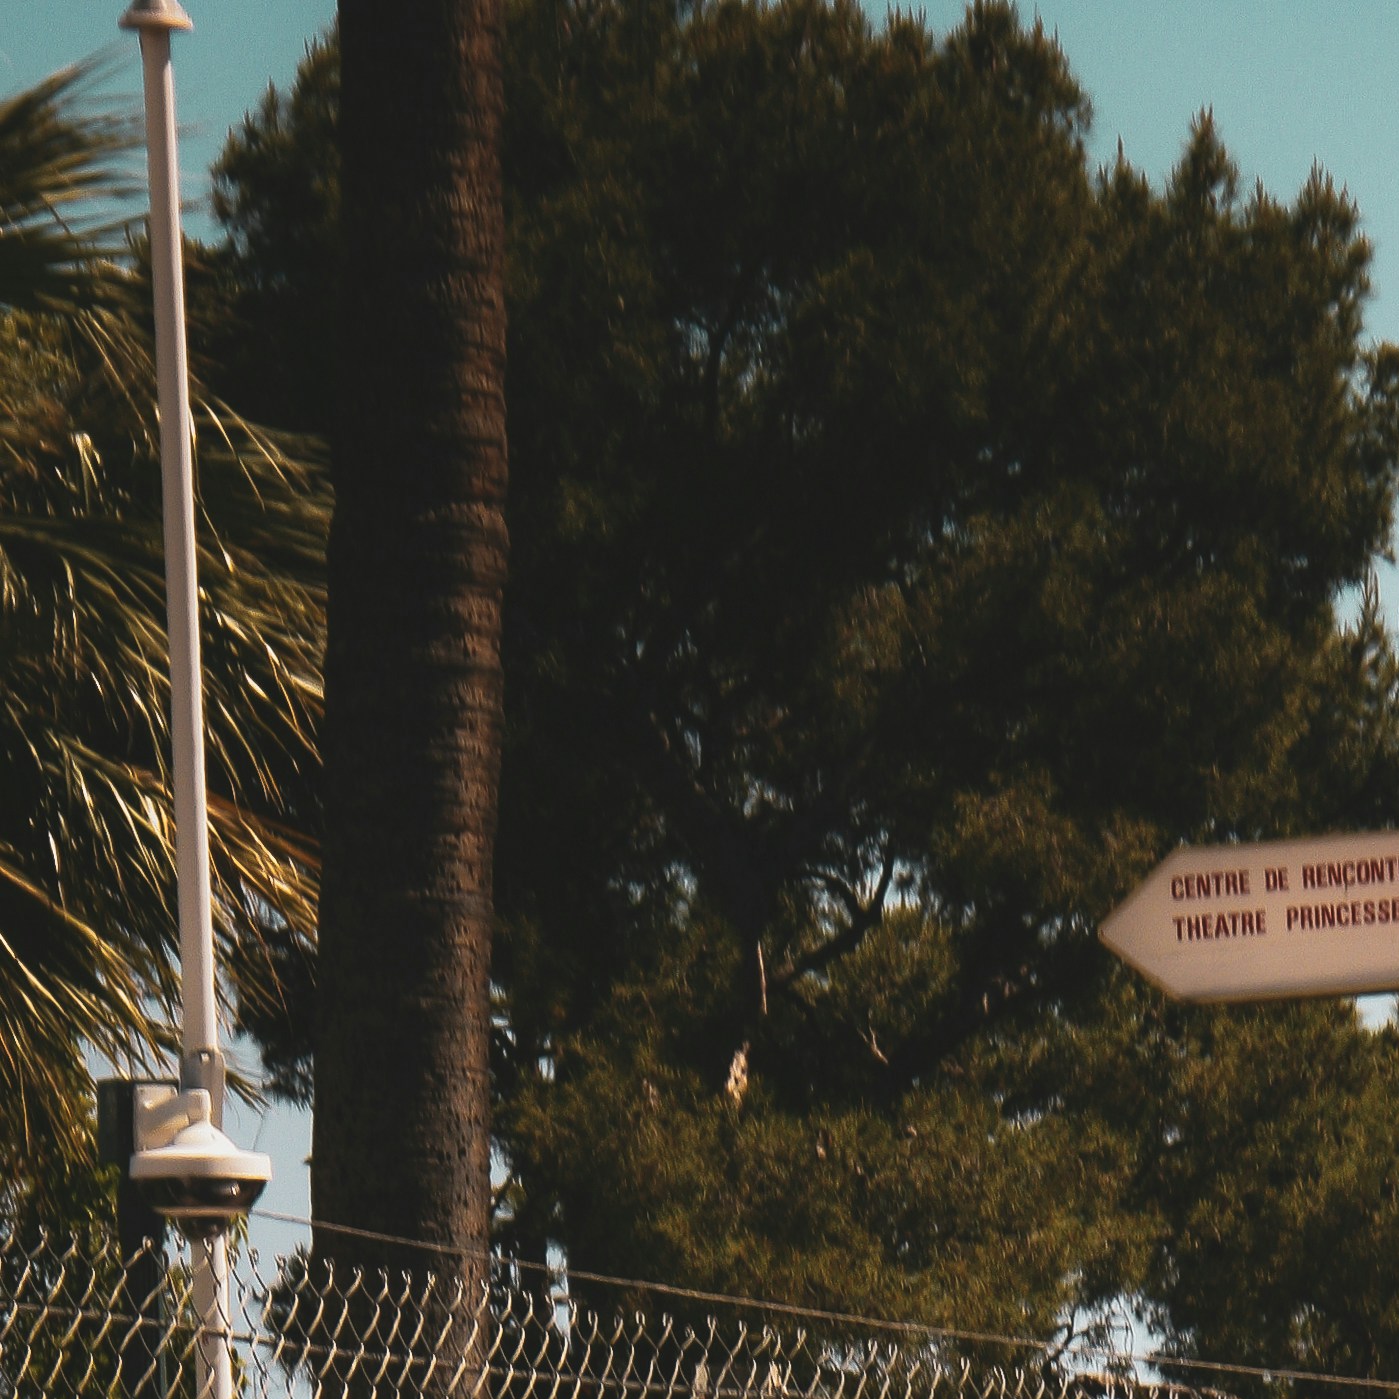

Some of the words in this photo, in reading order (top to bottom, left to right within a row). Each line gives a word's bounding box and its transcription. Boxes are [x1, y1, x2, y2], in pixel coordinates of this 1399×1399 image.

[1171, 868, 1250, 900] CENTRE
[1264, 866, 1289, 893] DE
[1172, 907, 1267, 942] THEATRE
